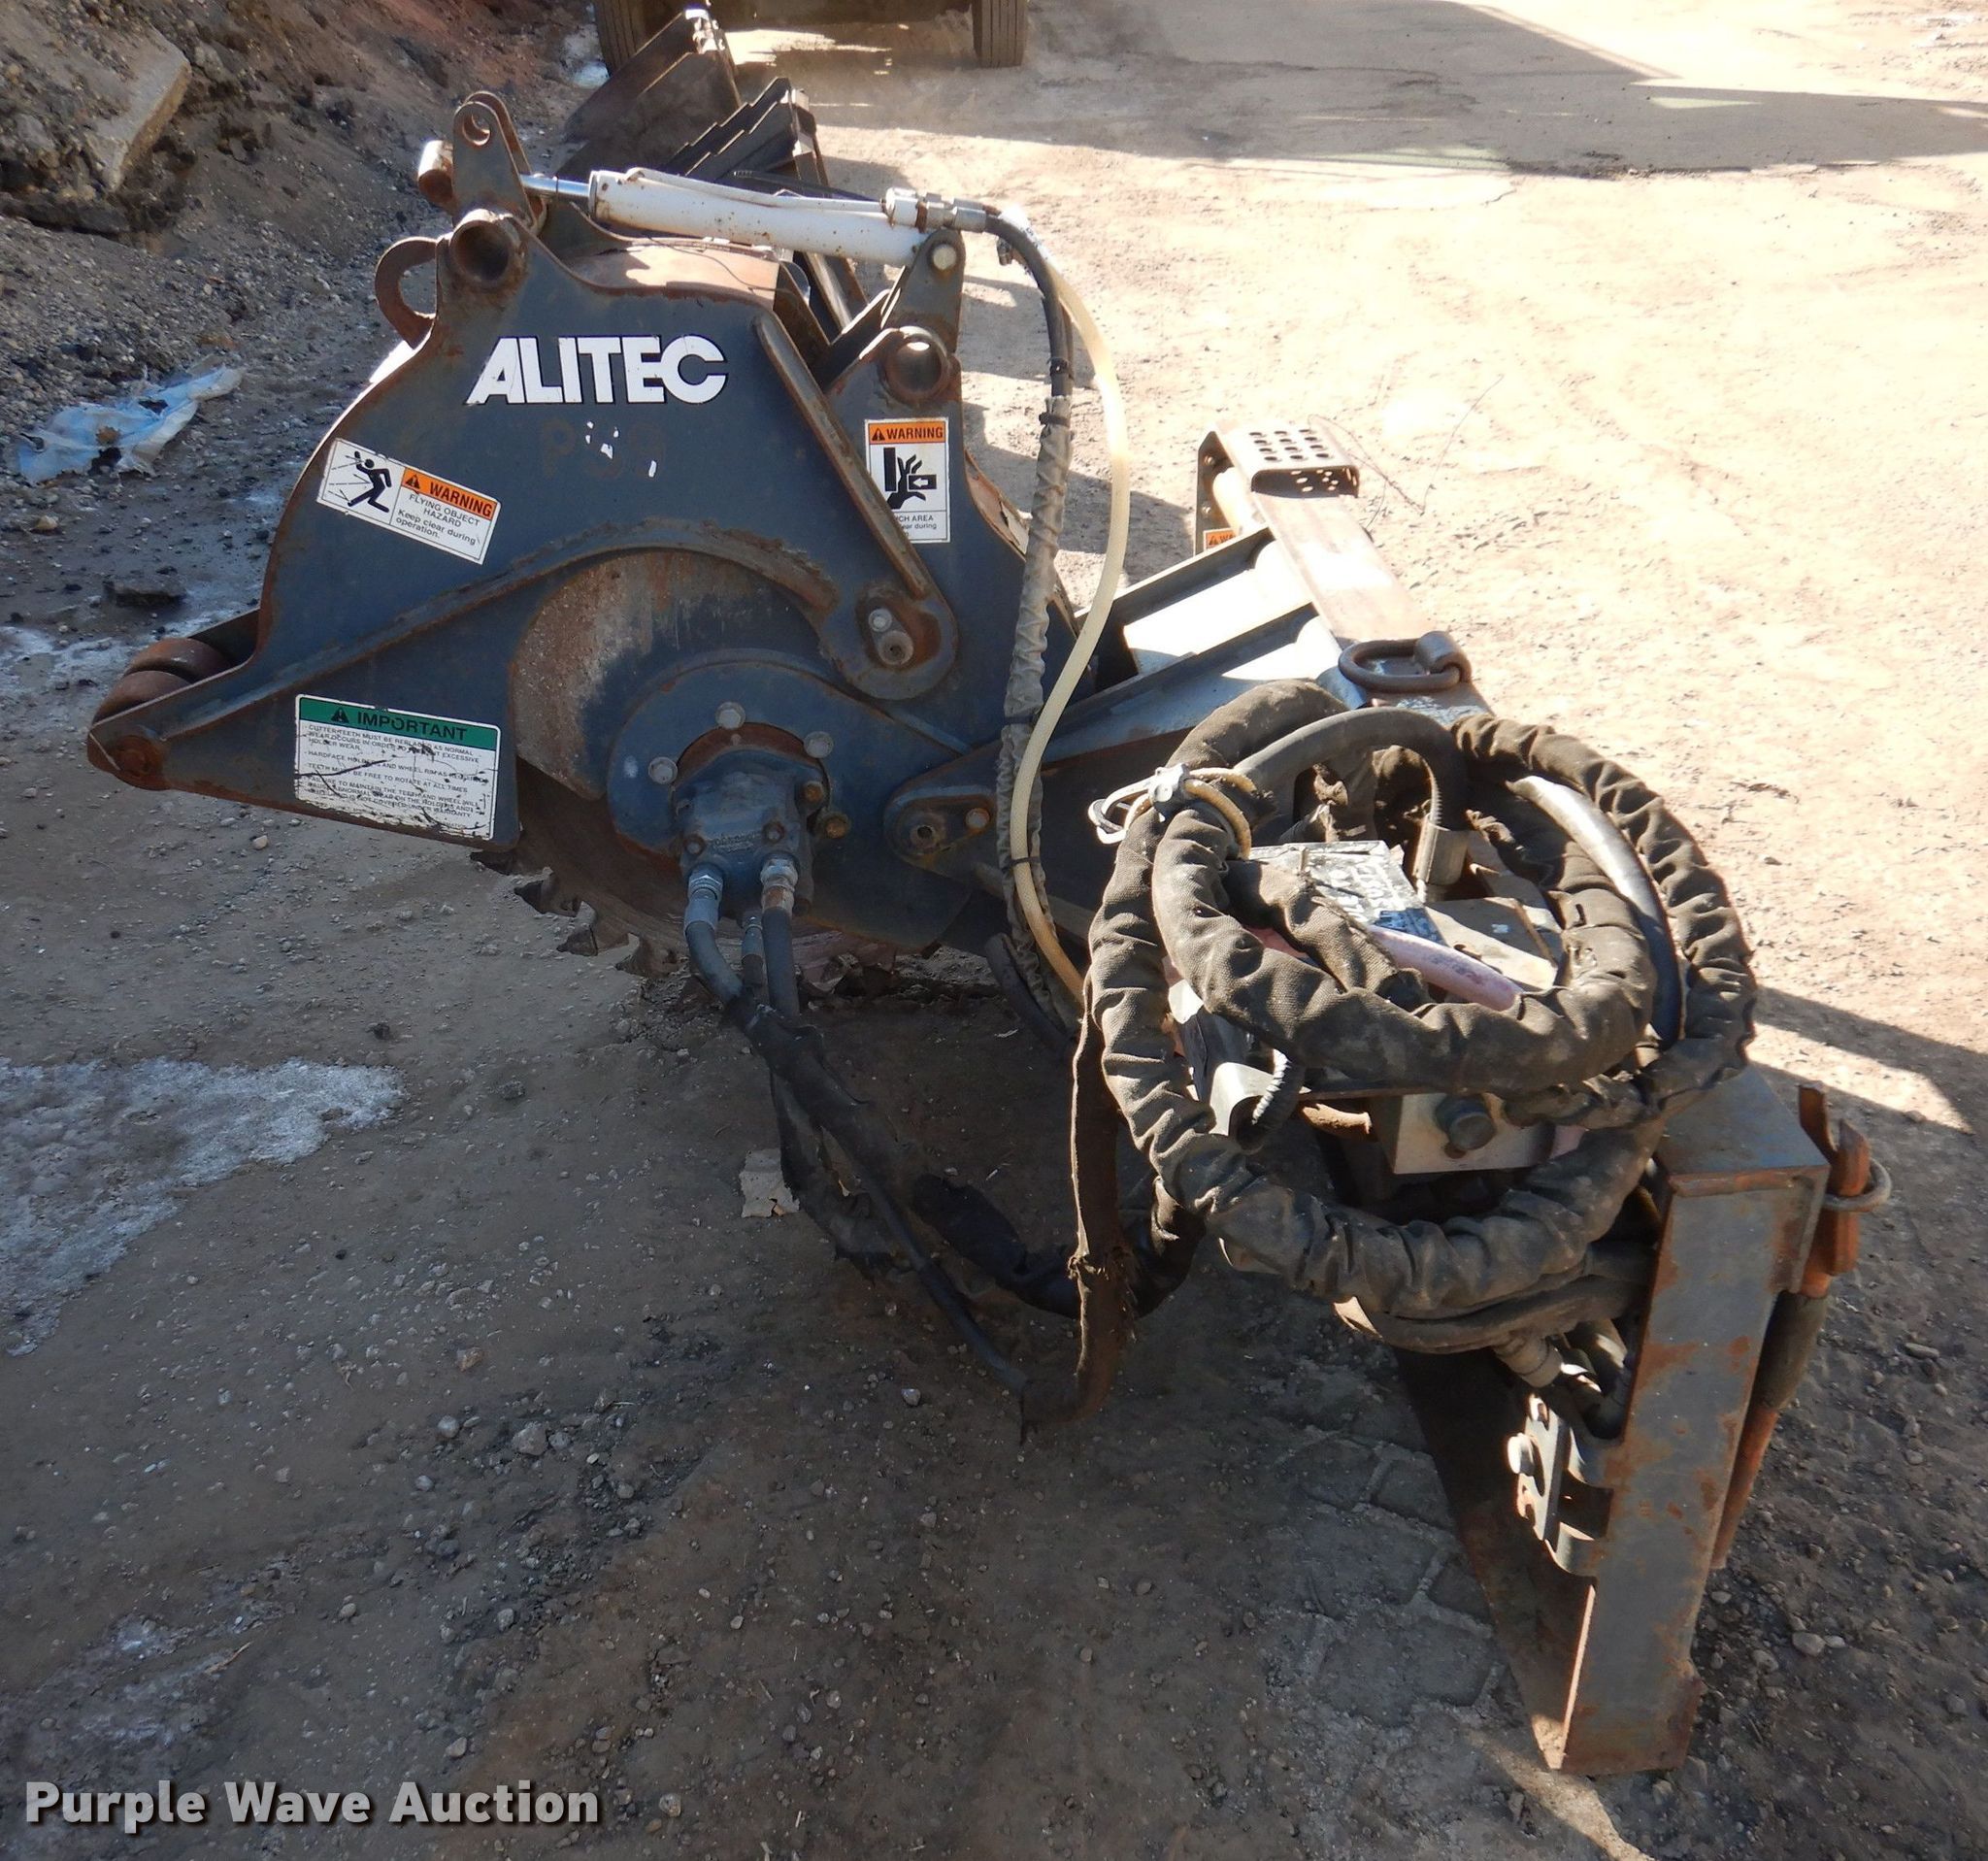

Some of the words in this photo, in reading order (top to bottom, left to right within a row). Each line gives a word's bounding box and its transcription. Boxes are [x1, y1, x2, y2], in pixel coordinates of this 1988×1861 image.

[465, 334, 727, 404] ALITEC
[887, 427, 943, 440] WARNING
[410, 494, 441, 511] FLYING
[444, 508, 480, 526] OBJECT
[429, 482, 492, 517] WARNING
[396, 517, 441, 539] operation.
[398, 509, 421, 523] Keep
[423, 518, 446, 533] clear
[447, 526, 477, 546] during
[423, 508, 462, 527] HAZARD
[357, 712, 467, 741] IMPORTANT
[443, 752, 479, 763] EXCESSIVE
[445, 747, 474, 755] NORMAL
